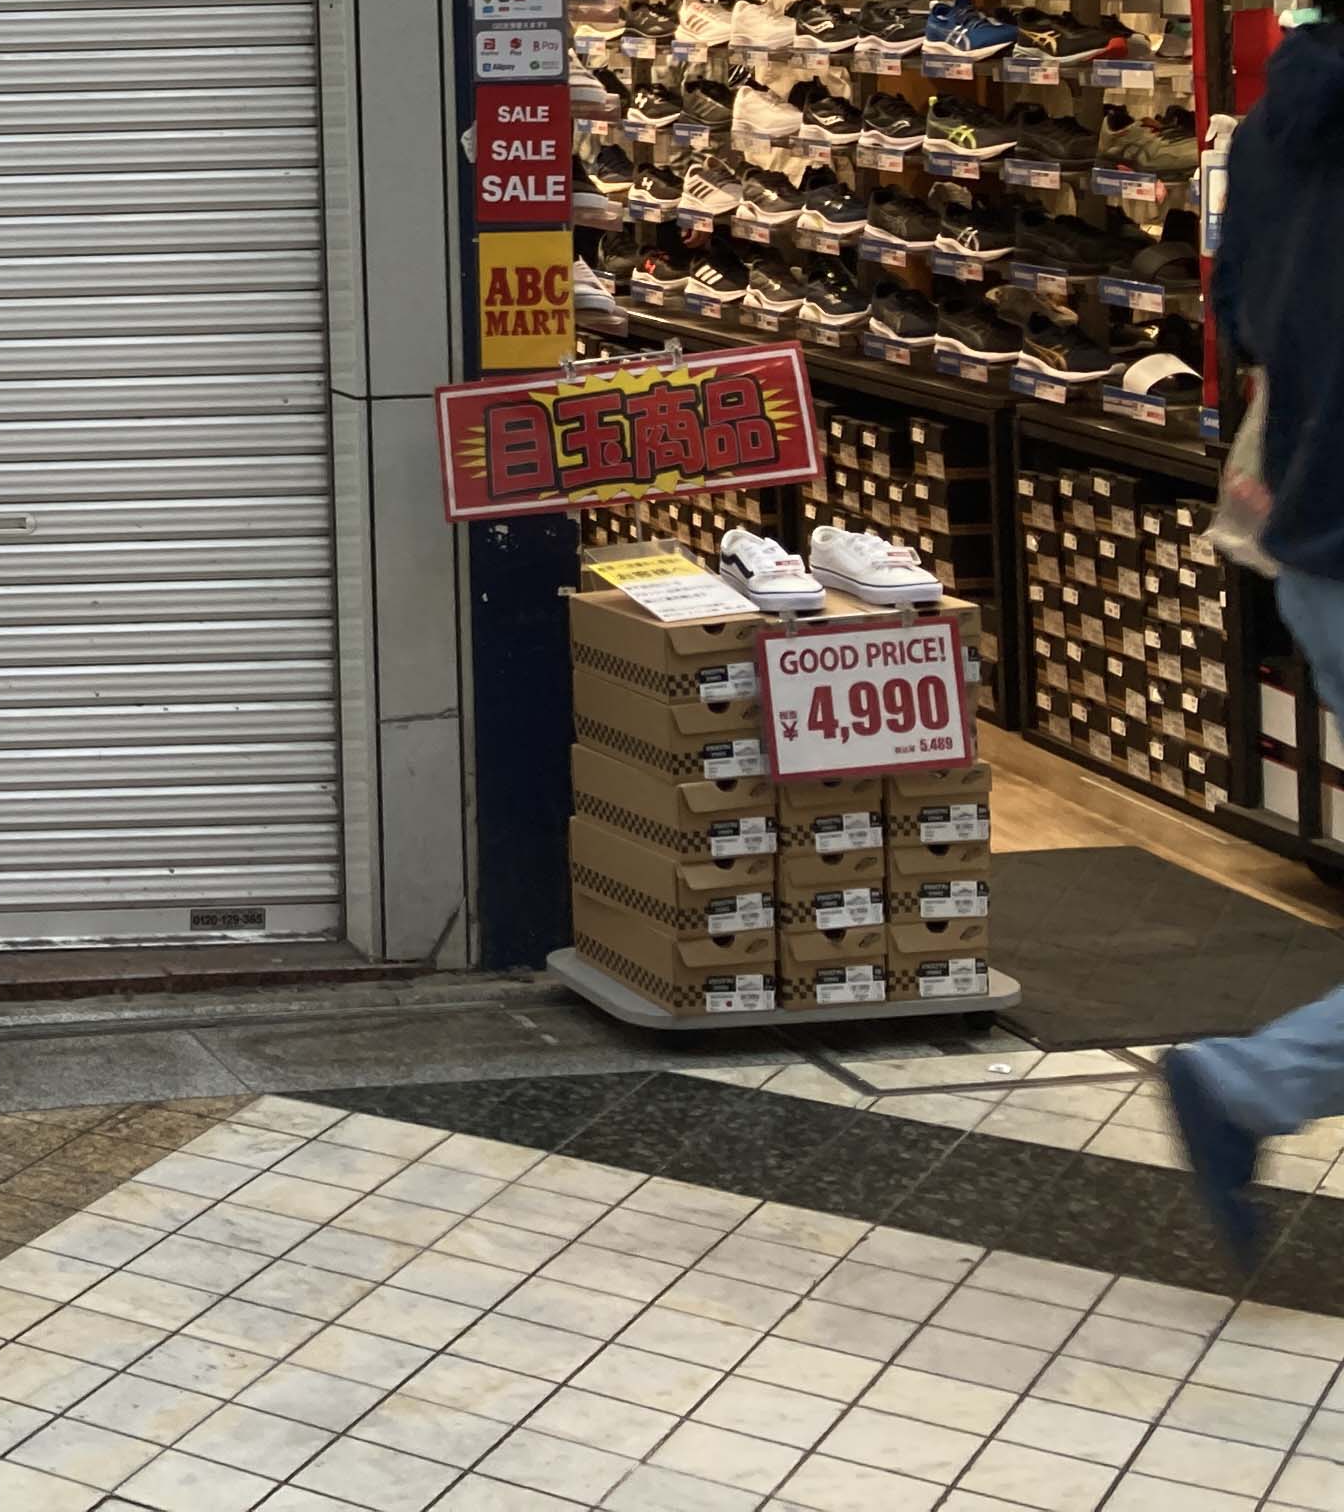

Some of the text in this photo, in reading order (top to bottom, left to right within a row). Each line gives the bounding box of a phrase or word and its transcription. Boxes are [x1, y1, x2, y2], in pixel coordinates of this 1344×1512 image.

[497, 105, 550, 123] SALE
[491, 140, 557, 161] SALE
[481, 175, 566, 203] SALE
[485, 264, 570, 307] ABC
[485, 308, 571, 337] MART
[486, 376, 777, 498] 目玉商品
[779, 636, 946, 675] GOOD PRICE!
[807, 675, 951, 744] 4,990
